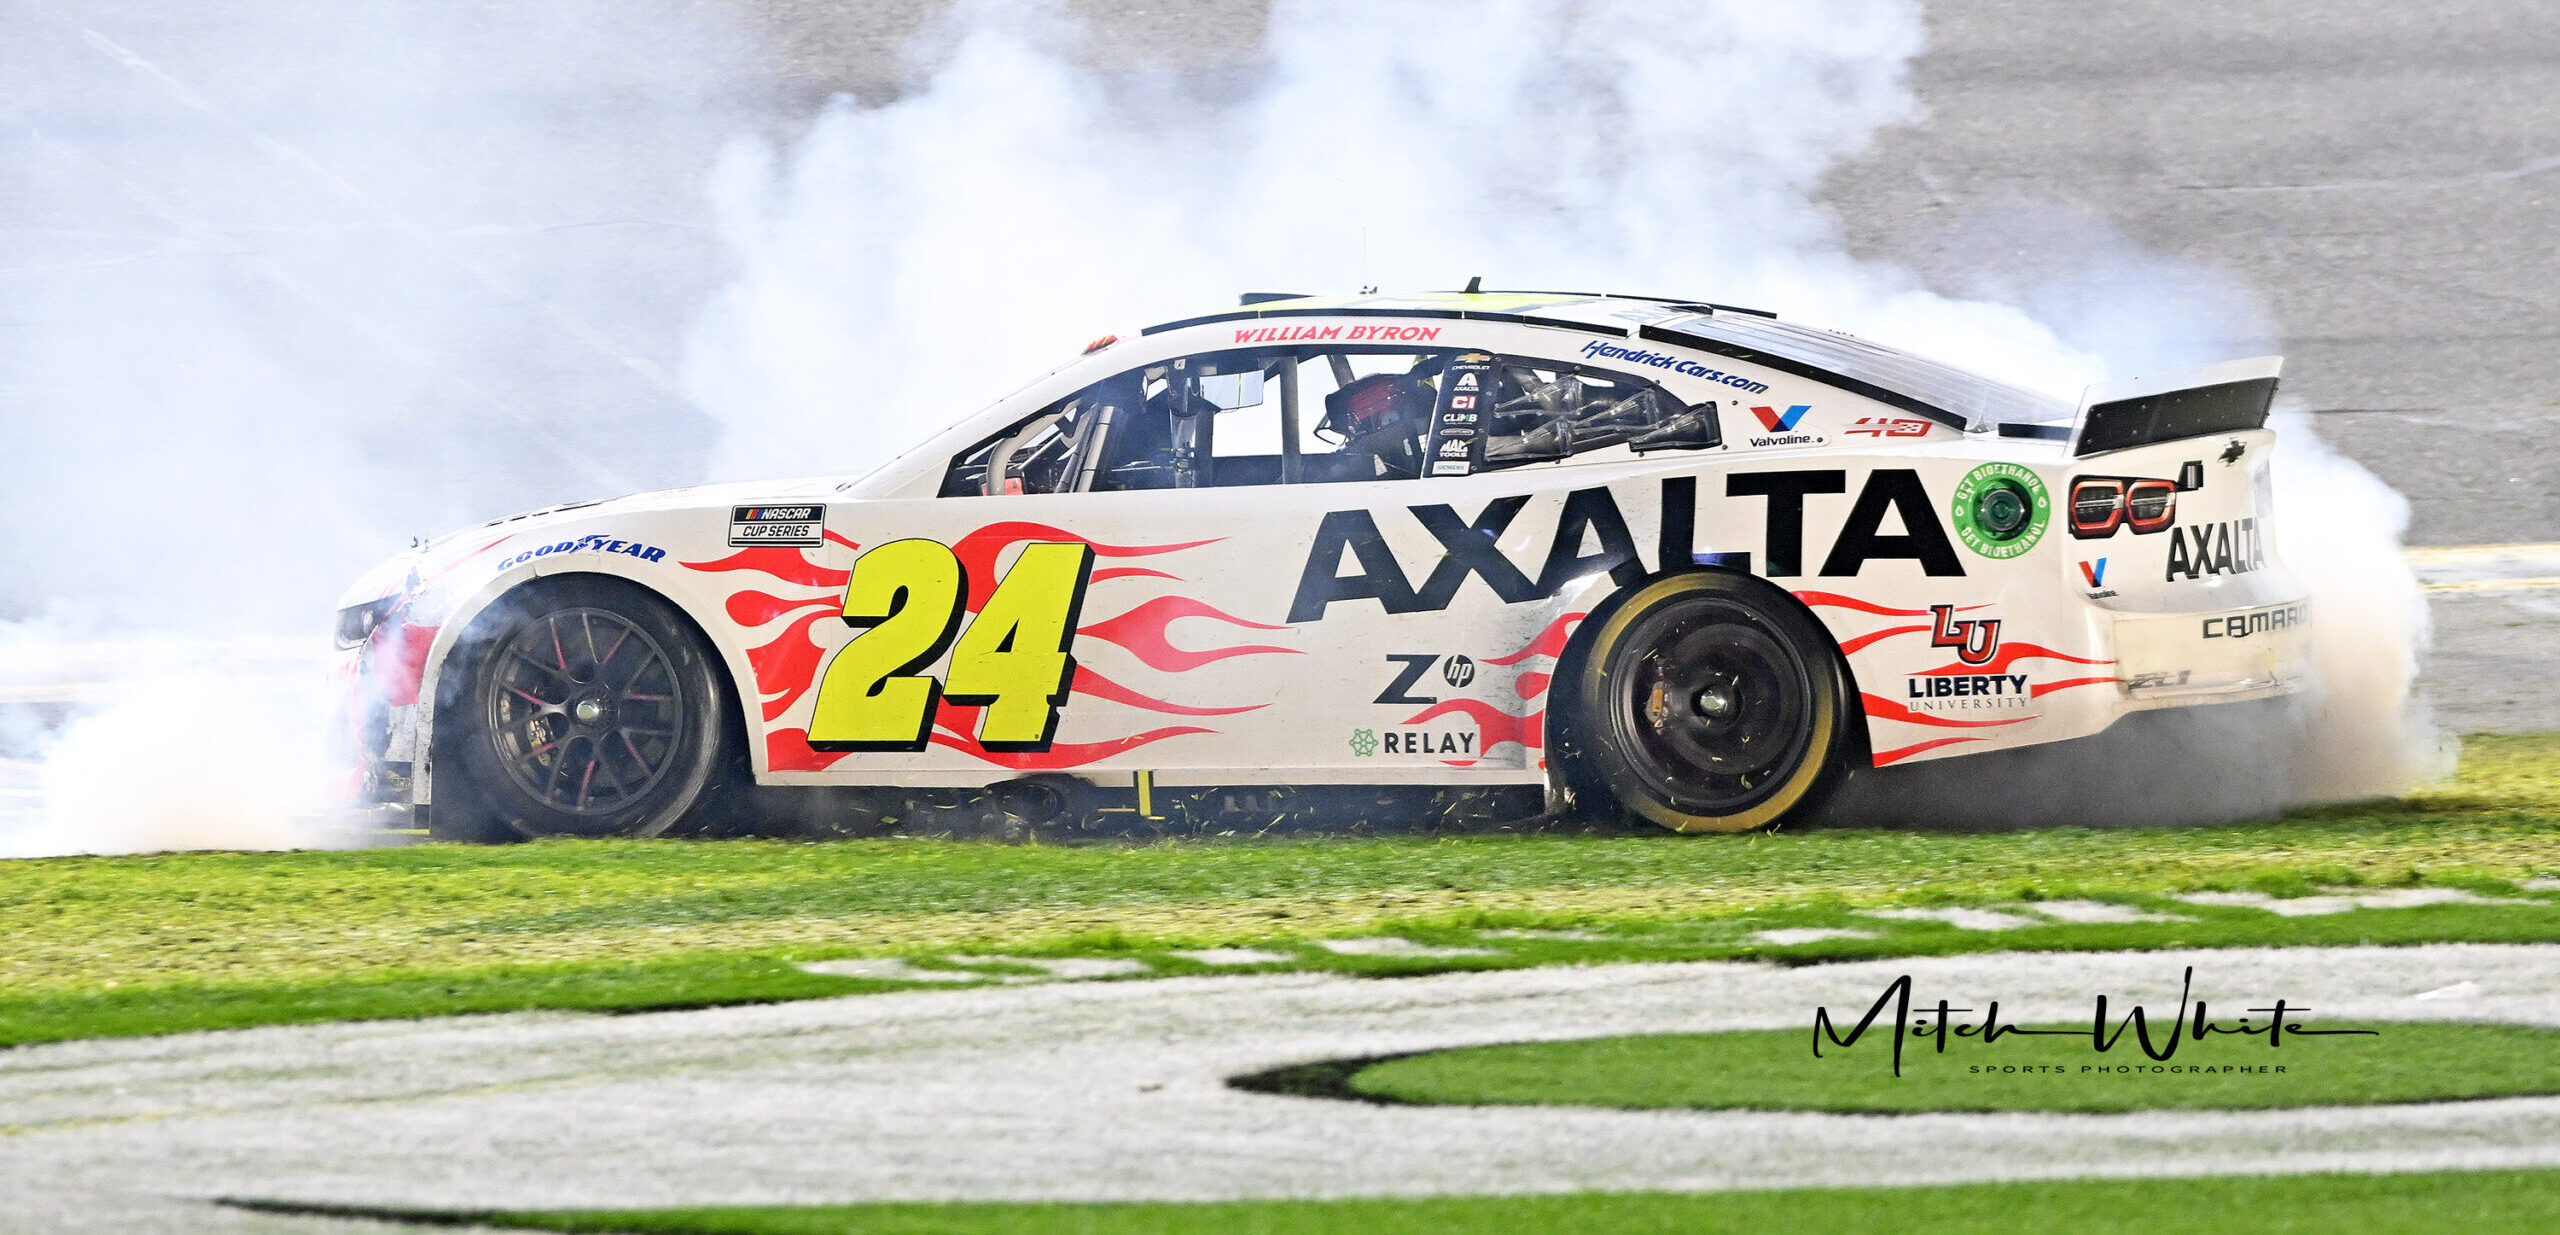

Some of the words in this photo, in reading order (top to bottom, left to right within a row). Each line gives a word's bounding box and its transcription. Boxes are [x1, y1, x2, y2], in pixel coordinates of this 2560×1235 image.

[1234, 326, 1342, 344] WILLIAM
[1346, 325, 1441, 341] BYRON
[1452, 396, 1476, 409] CI
[1750, 434, 1811, 447] Valvoline
[1956, 478, 1975, 499] GET
[1973, 464, 2042, 494] BIOETHANOL
[762, 507, 811, 520] NASCAR
[742, 526, 767, 537] CUP
[768, 525, 810, 537] SERIES
[1286, 468, 1967, 623] AXALTA
[1961, 527, 1980, 547] GET
[1980, 520, 2045, 557] BIOETHANOL
[498, 534, 666, 571] GOODYEAR
[2166, 517, 2268, 582] AXALTA
[1930, 604, 2001, 664] LU
[2203, 604, 2308, 638] CAMARO
[807, 538, 1095, 752] 24
[1372, 654, 1441, 704] Z
[1444, 654, 1475, 688] hp
[1908, 675, 2028, 698] LIBERTY
[1910, 698, 2028, 711] UNIVERSITY
[1384, 732, 1474, 753] RELAY
